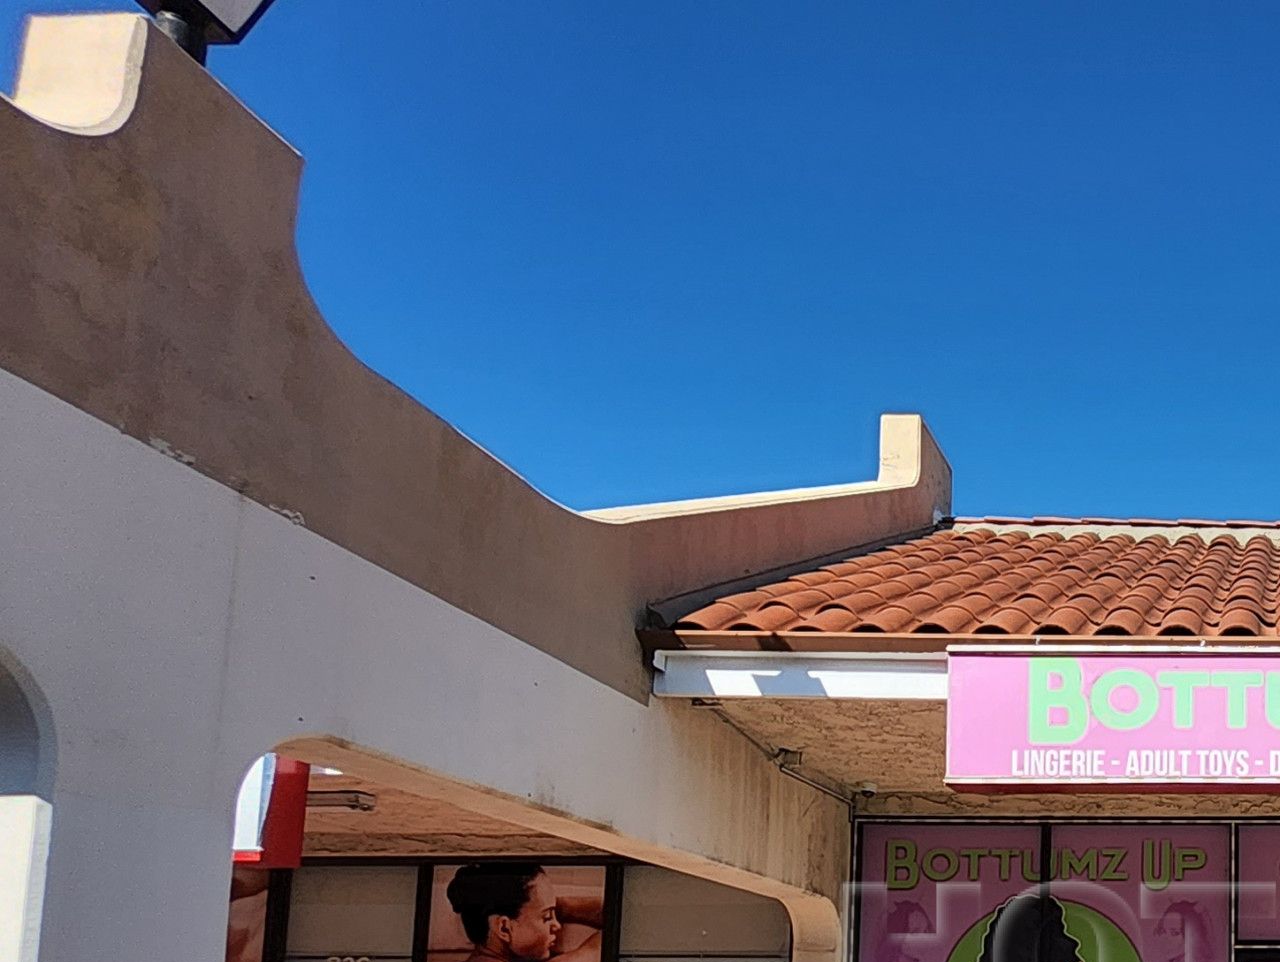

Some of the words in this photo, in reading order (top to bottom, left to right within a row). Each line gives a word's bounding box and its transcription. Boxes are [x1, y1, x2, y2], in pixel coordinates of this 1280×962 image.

[1011, 750, 1105, 777] LINGERIE
[1125, 750, 1191, 777] ADULT
[1197, 750, 1249, 777] TOYS
